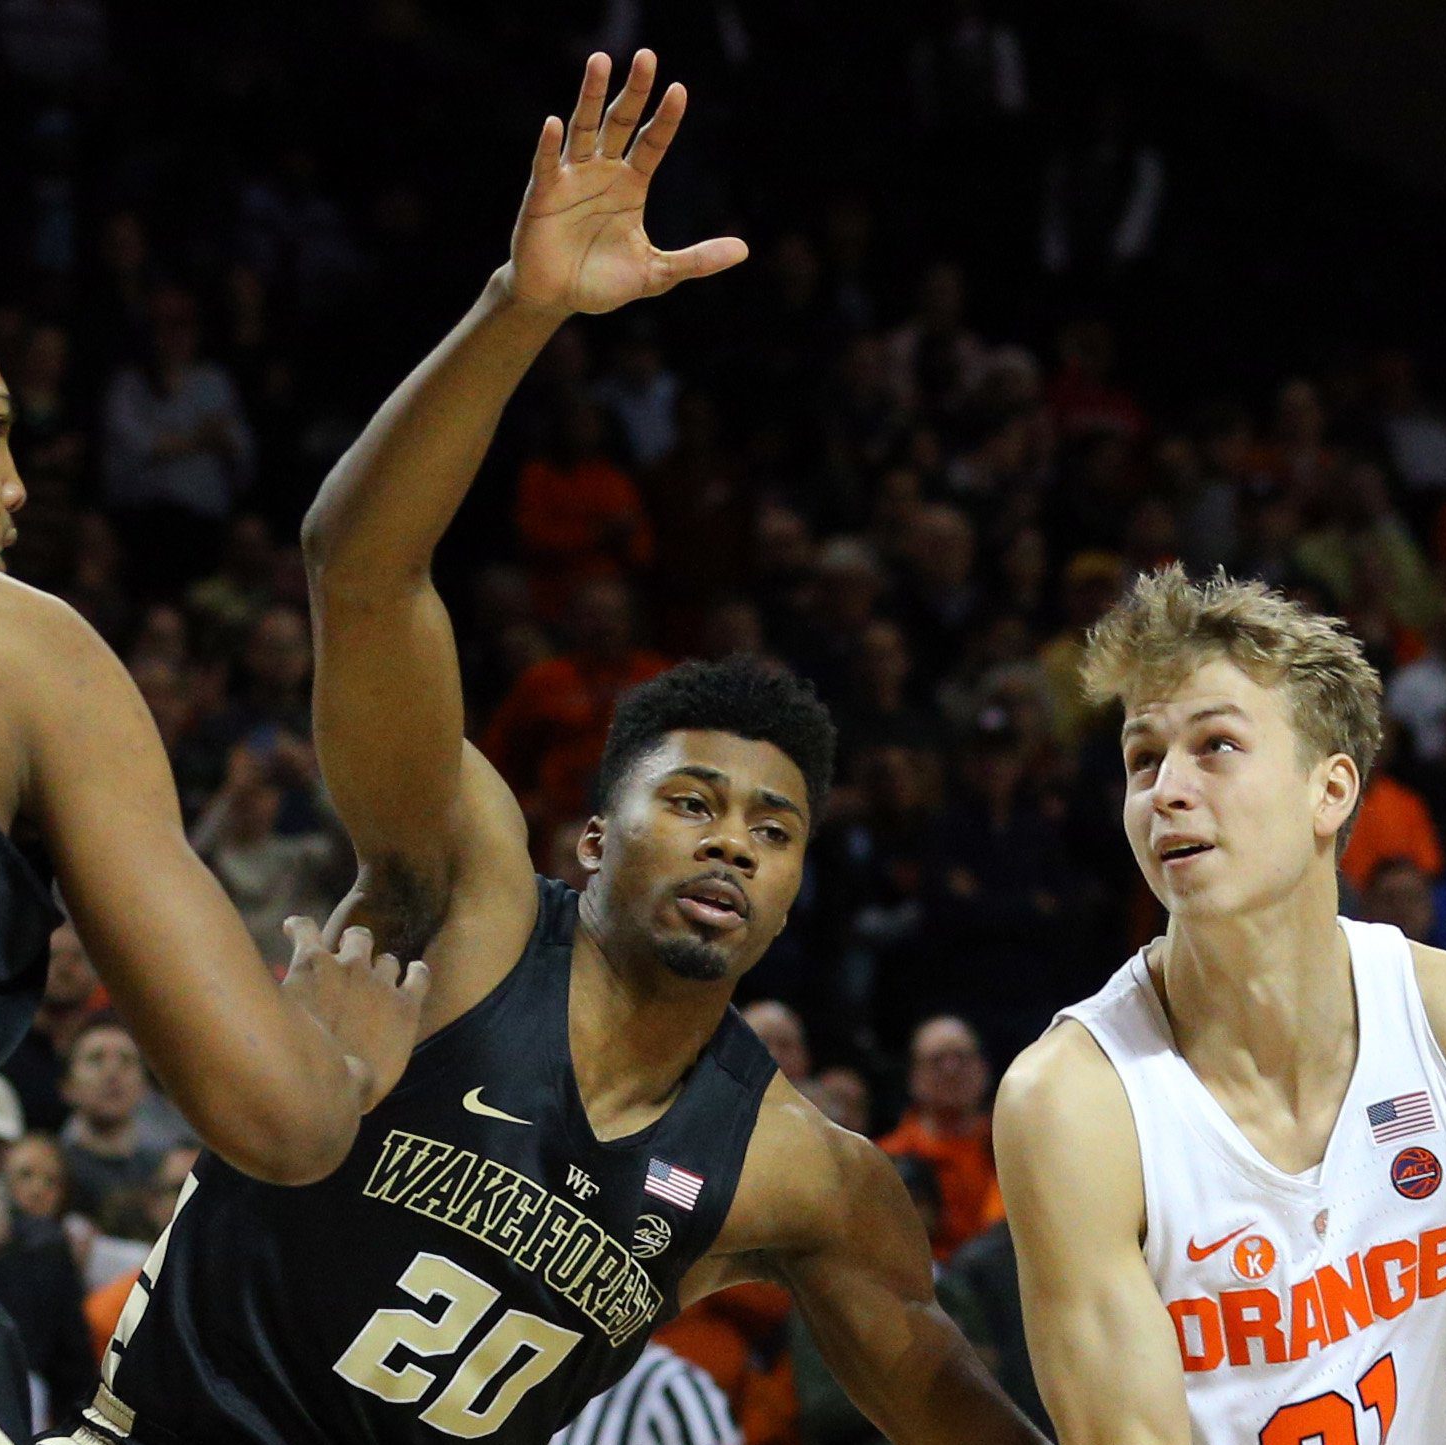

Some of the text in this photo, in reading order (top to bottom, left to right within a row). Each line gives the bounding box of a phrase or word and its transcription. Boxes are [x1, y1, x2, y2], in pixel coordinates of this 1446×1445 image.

[564, 1163, 600, 1201] WF
[1246, 1252, 1266, 1278] K
[332, 1250, 585, 1440] 20
